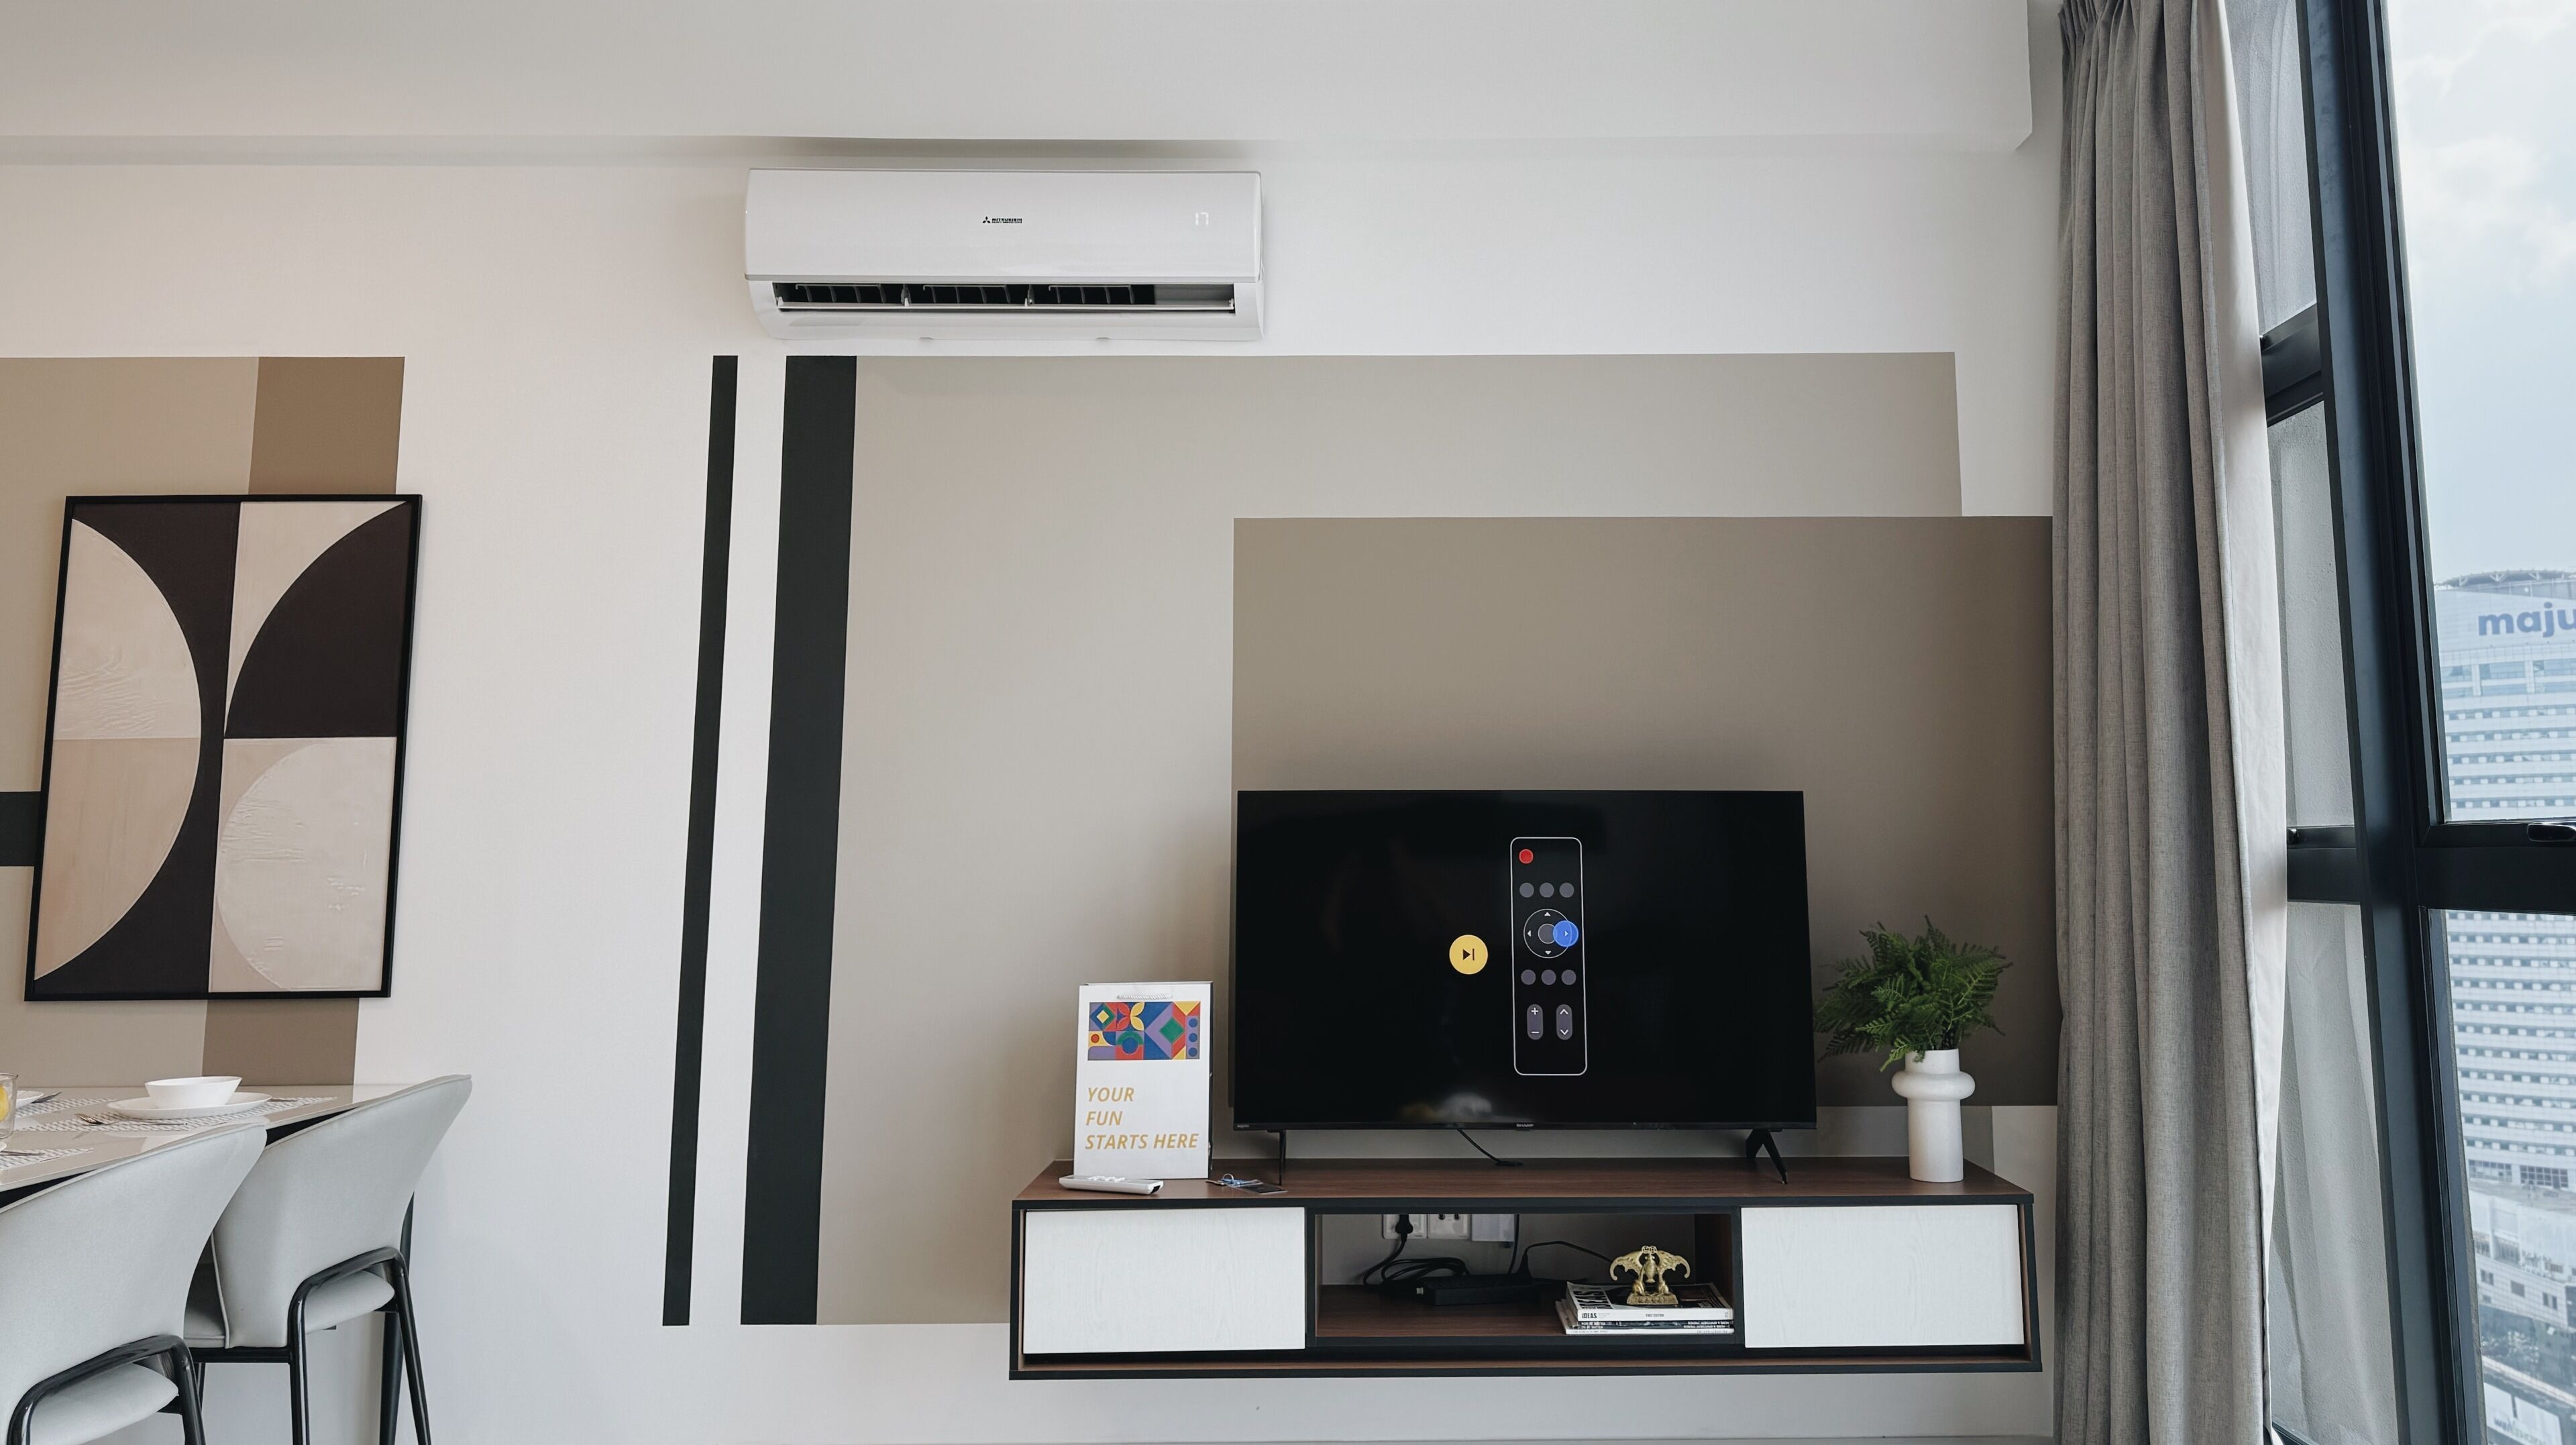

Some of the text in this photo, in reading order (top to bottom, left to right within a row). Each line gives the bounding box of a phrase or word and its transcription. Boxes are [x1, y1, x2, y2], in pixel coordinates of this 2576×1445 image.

[1087, 1087, 1134, 1102] YOUR
[1085, 1111, 1123, 1126] FUN
[1085, 1133, 1199, 1149] STARTS HERE
